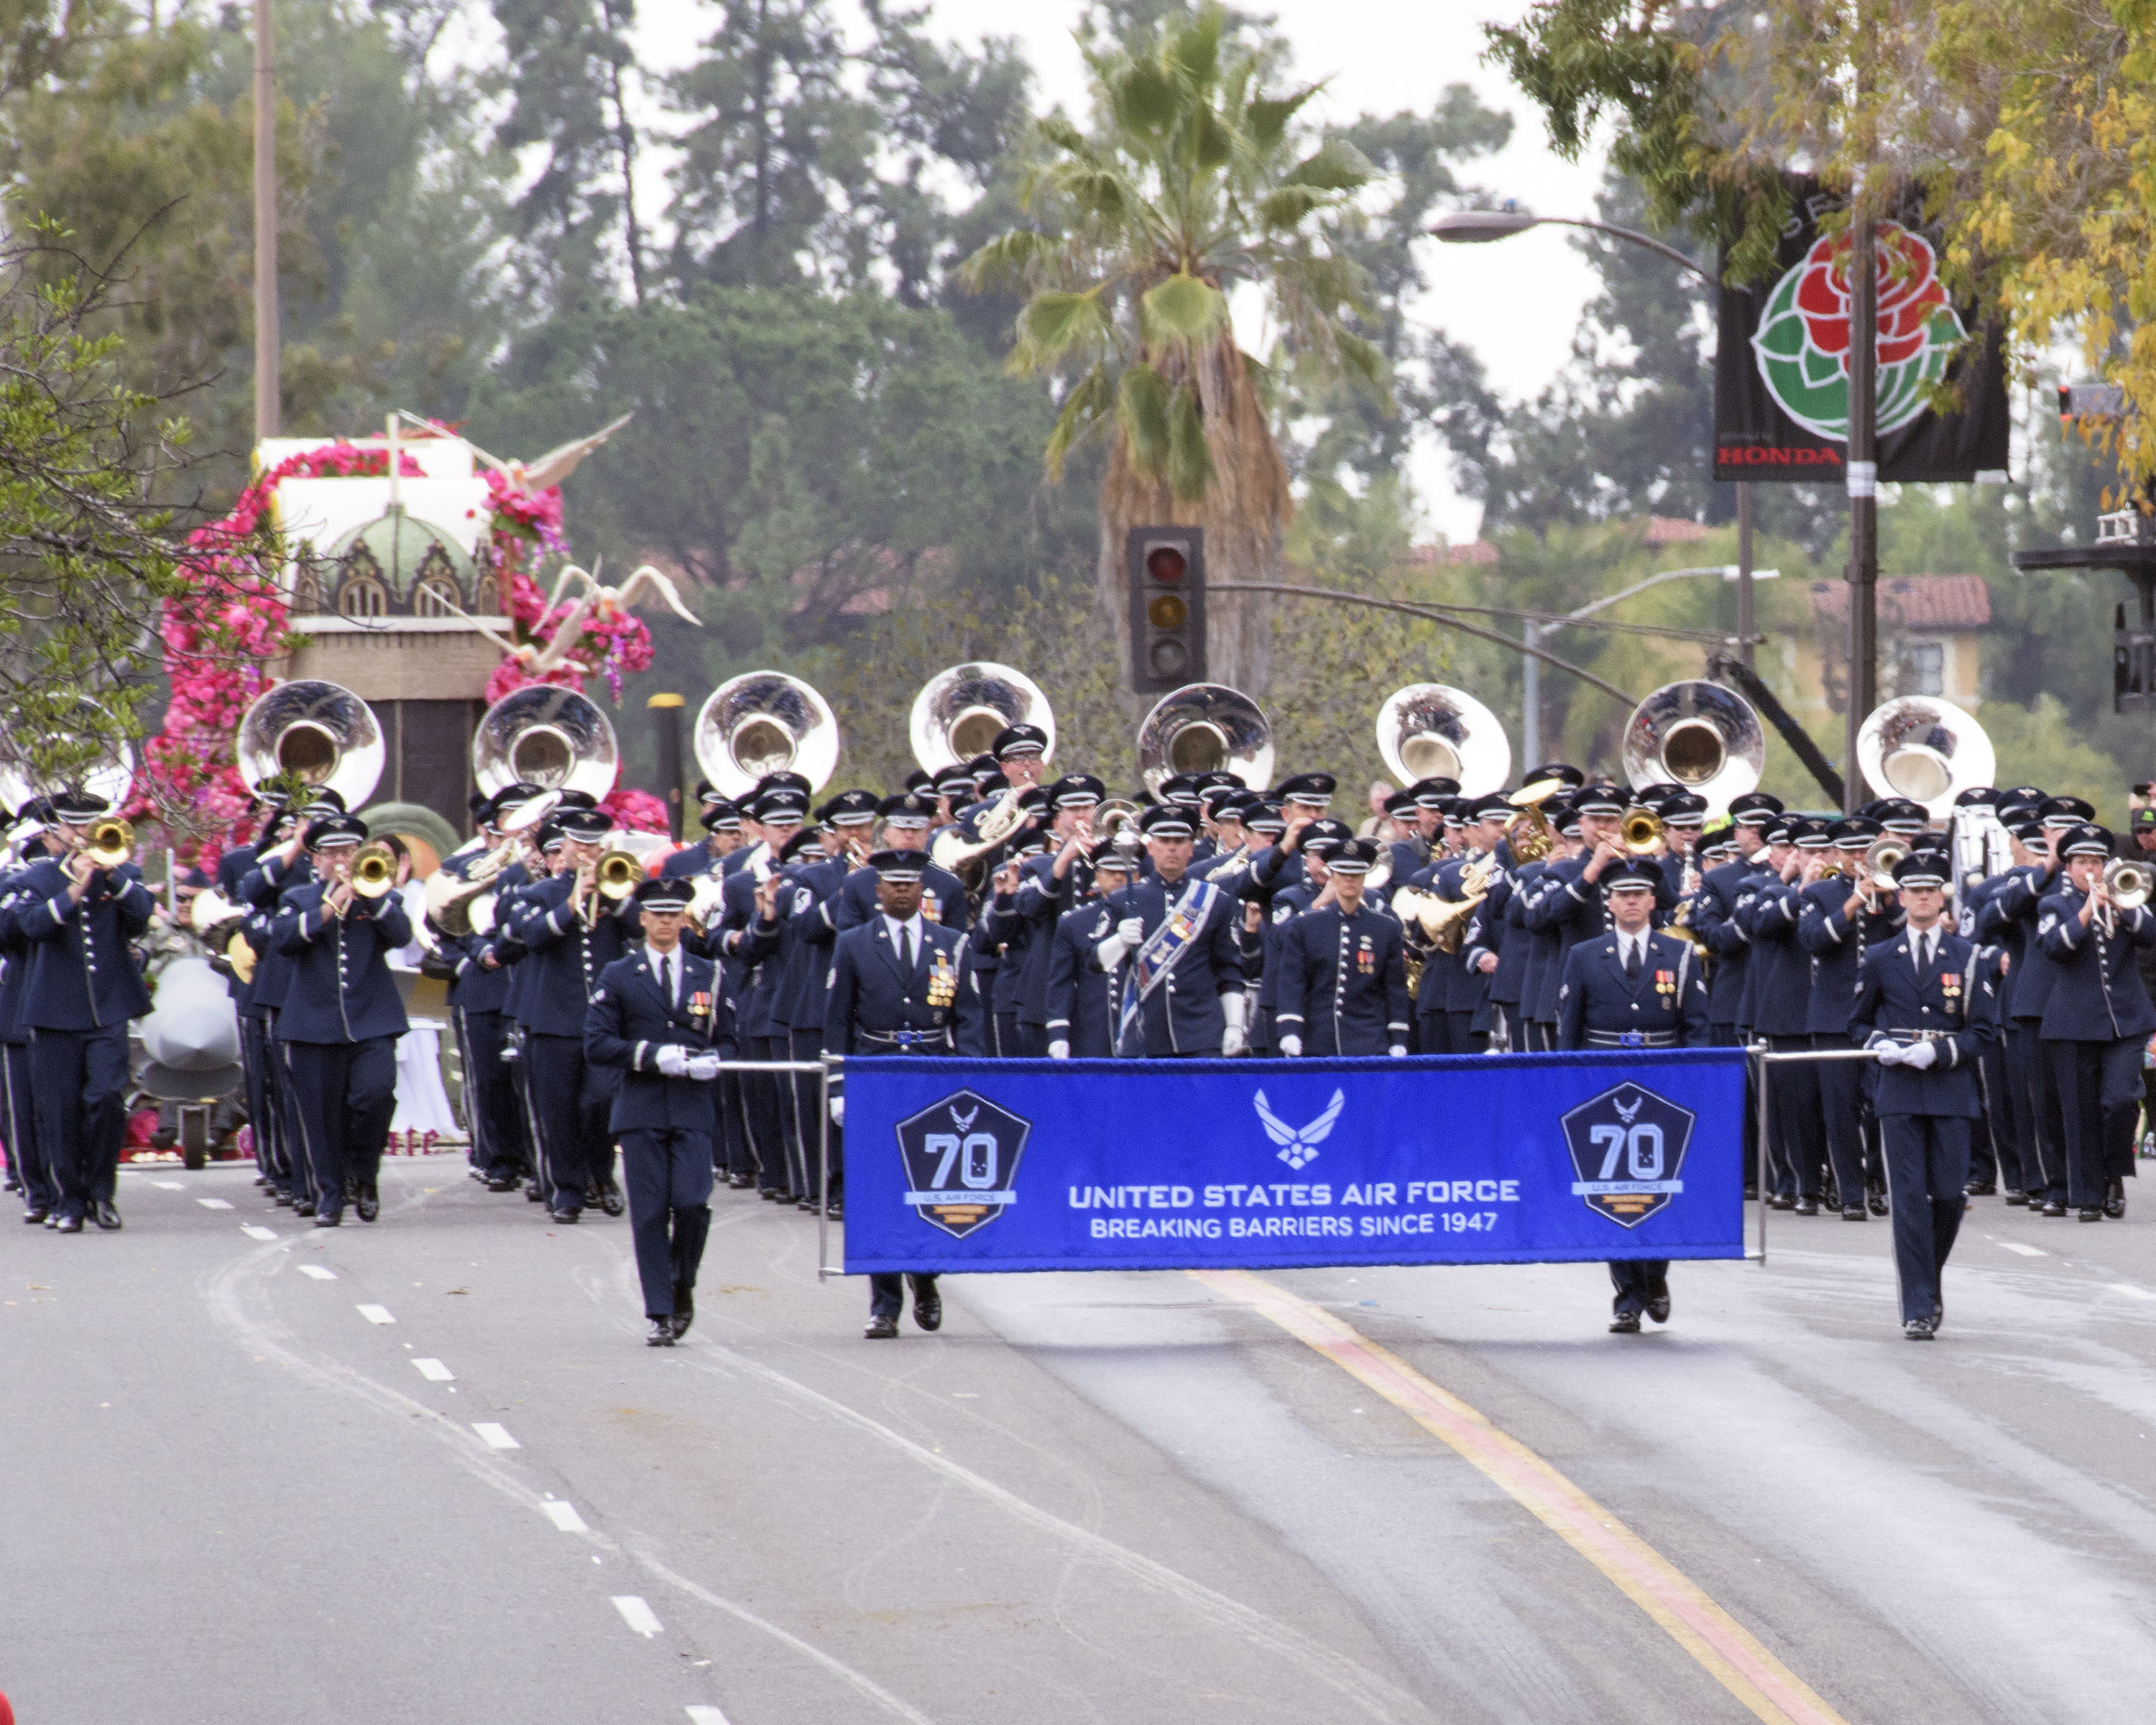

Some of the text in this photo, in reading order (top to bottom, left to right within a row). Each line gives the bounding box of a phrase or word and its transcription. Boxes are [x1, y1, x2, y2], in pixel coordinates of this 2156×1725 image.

[1717, 446, 1842, 464] HONDA
[924, 1133, 998, 1189] 70
[1590, 1123, 1664, 1179] 70
[963, 1193, 997, 1202] FORCE
[1069, 1179, 1521, 1209] UNITED STATES AIR FORCE
[1631, 1182, 1663, 1191] FORCE
[1090, 1212, 1498, 1238] BREAKING BARRIERS SINCE 1947
